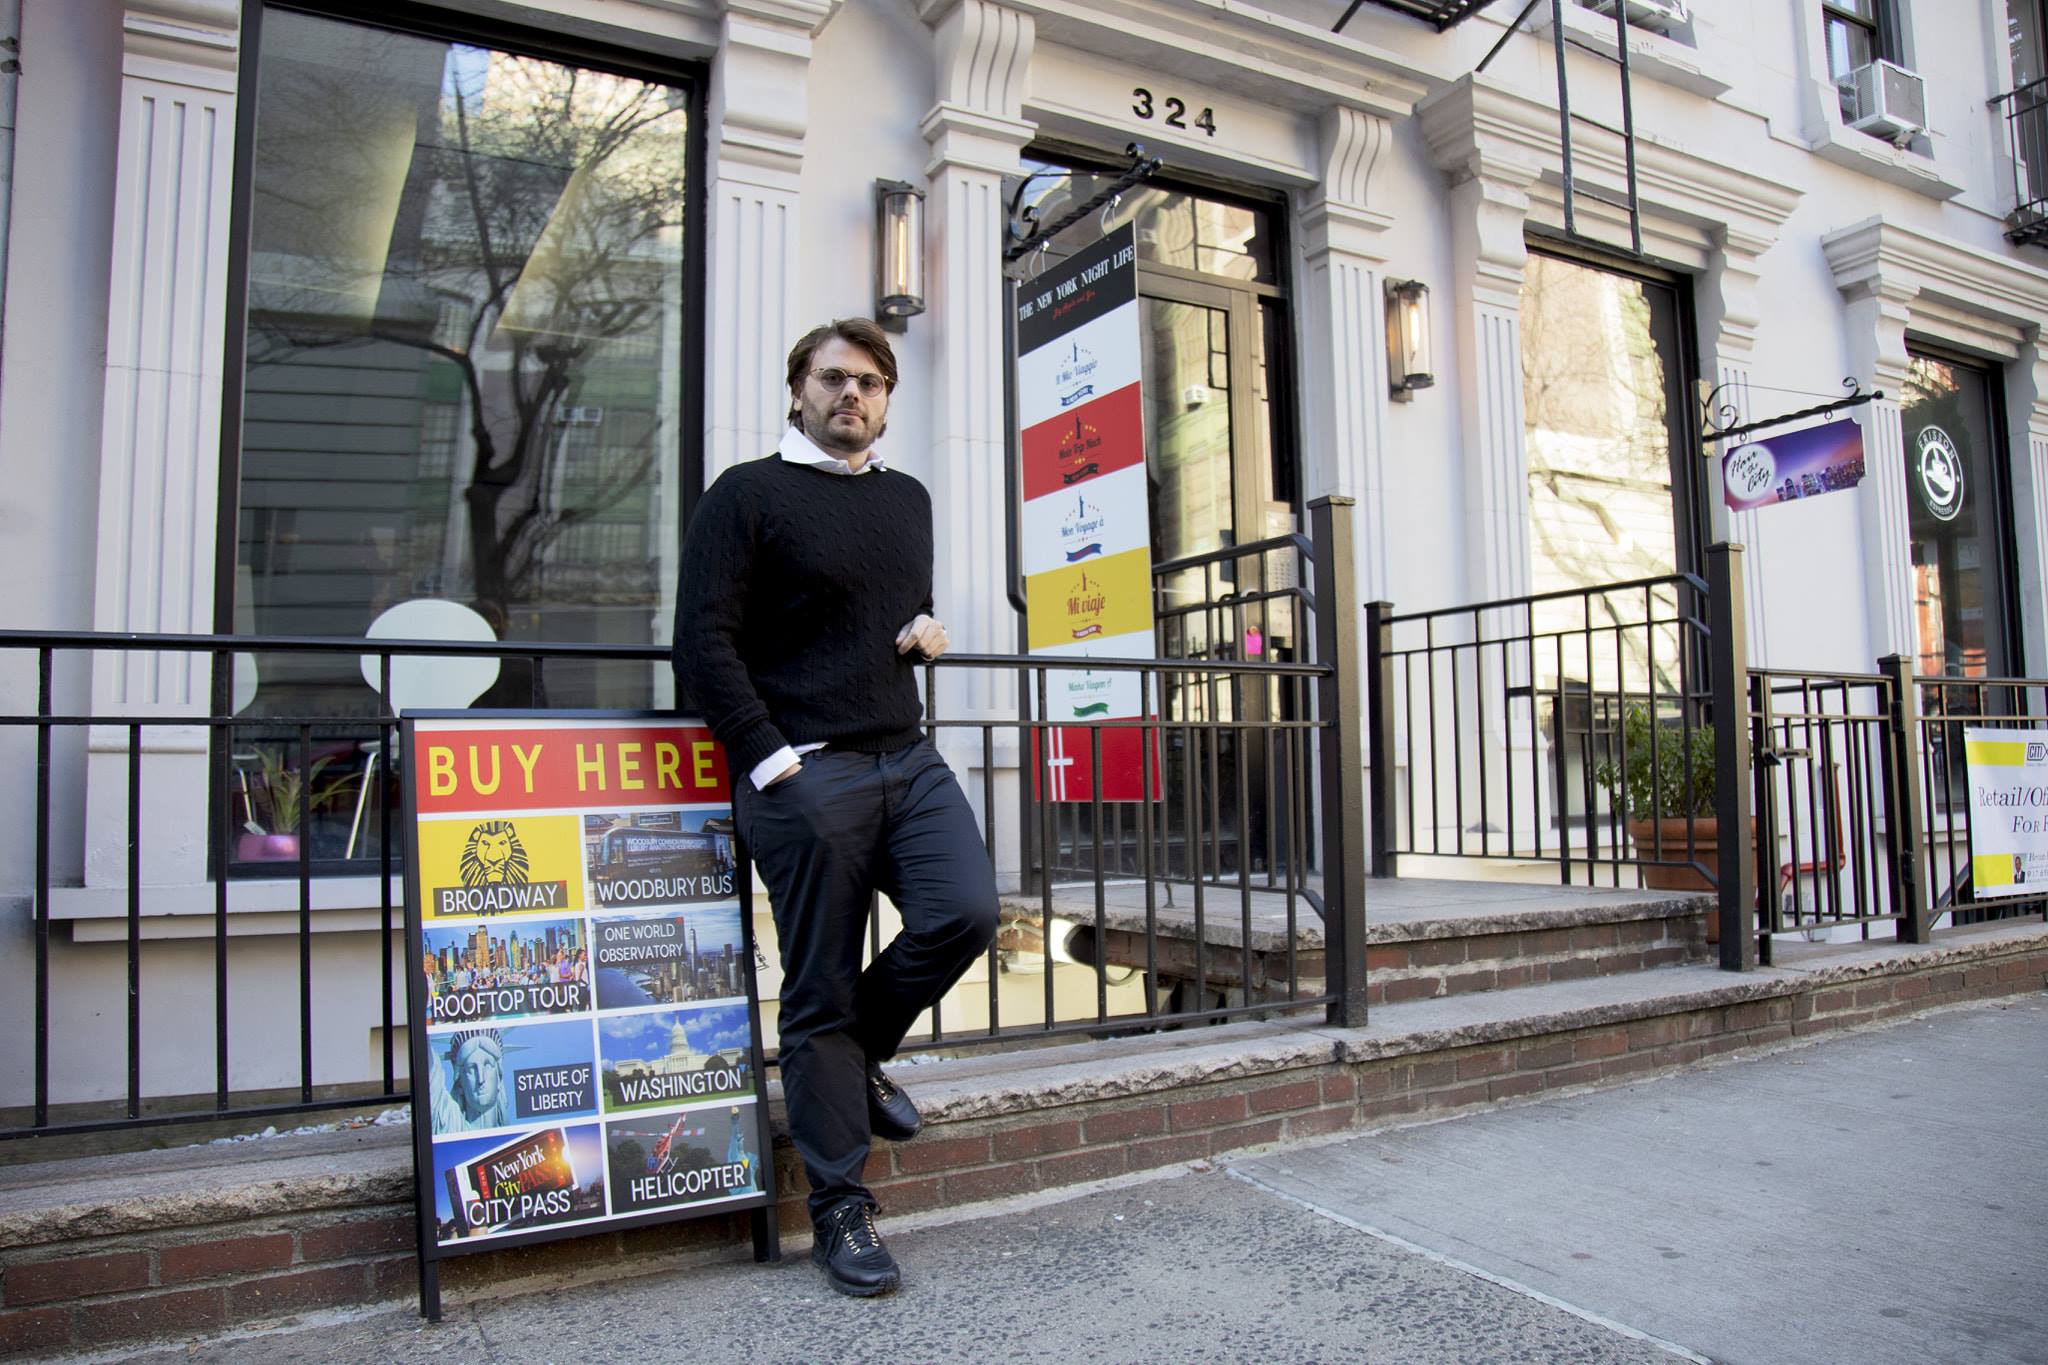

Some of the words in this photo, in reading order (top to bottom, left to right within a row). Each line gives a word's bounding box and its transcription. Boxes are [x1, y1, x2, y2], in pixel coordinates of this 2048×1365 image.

[1132, 87, 1216, 137] 324
[1018, 301, 1034, 321] THE
[1036, 290, 1053, 312] NEW
[1056, 276, 1078, 300] YORK
[1081, 258, 1110, 287] NIGHT
[1113, 244, 1134, 270] LIFE
[1918, 429, 1955, 461] FRISSON
[1747, 467, 1772, 493] City
[1928, 498, 1953, 516] ESPRESSO
[1066, 597, 1080, 616] Mi
[1081, 592, 1106, 617] viaje
[428, 744, 543, 797] BUY
[575, 741, 719, 791] HERE
[441, 884, 559, 913] BROADWAY
[597, 877, 698, 902] WOODBURY
[701, 875, 734, 896] BUS
[604, 926, 632, 942] ONE
[632, 923, 676, 939] WORLD
[599, 943, 684, 963] OBSERVATORY
[432, 988, 526, 1018] ROOFTOP
[527, 984, 581, 1010] TOUR
[518, 1071, 569, 1092] STATUE
[571, 1068, 590, 1086] OF
[619, 1067, 742, 1103] WASHINGTON
[531, 1091, 584, 1112] LIBERTY
[492, 1156, 521, 1184] New
[516, 1144, 546, 1171] York
[631, 1163, 746, 1203] HELICOPTER
[468, 1198, 516, 1226] CITY
[520, 1189, 571, 1219] PASS
